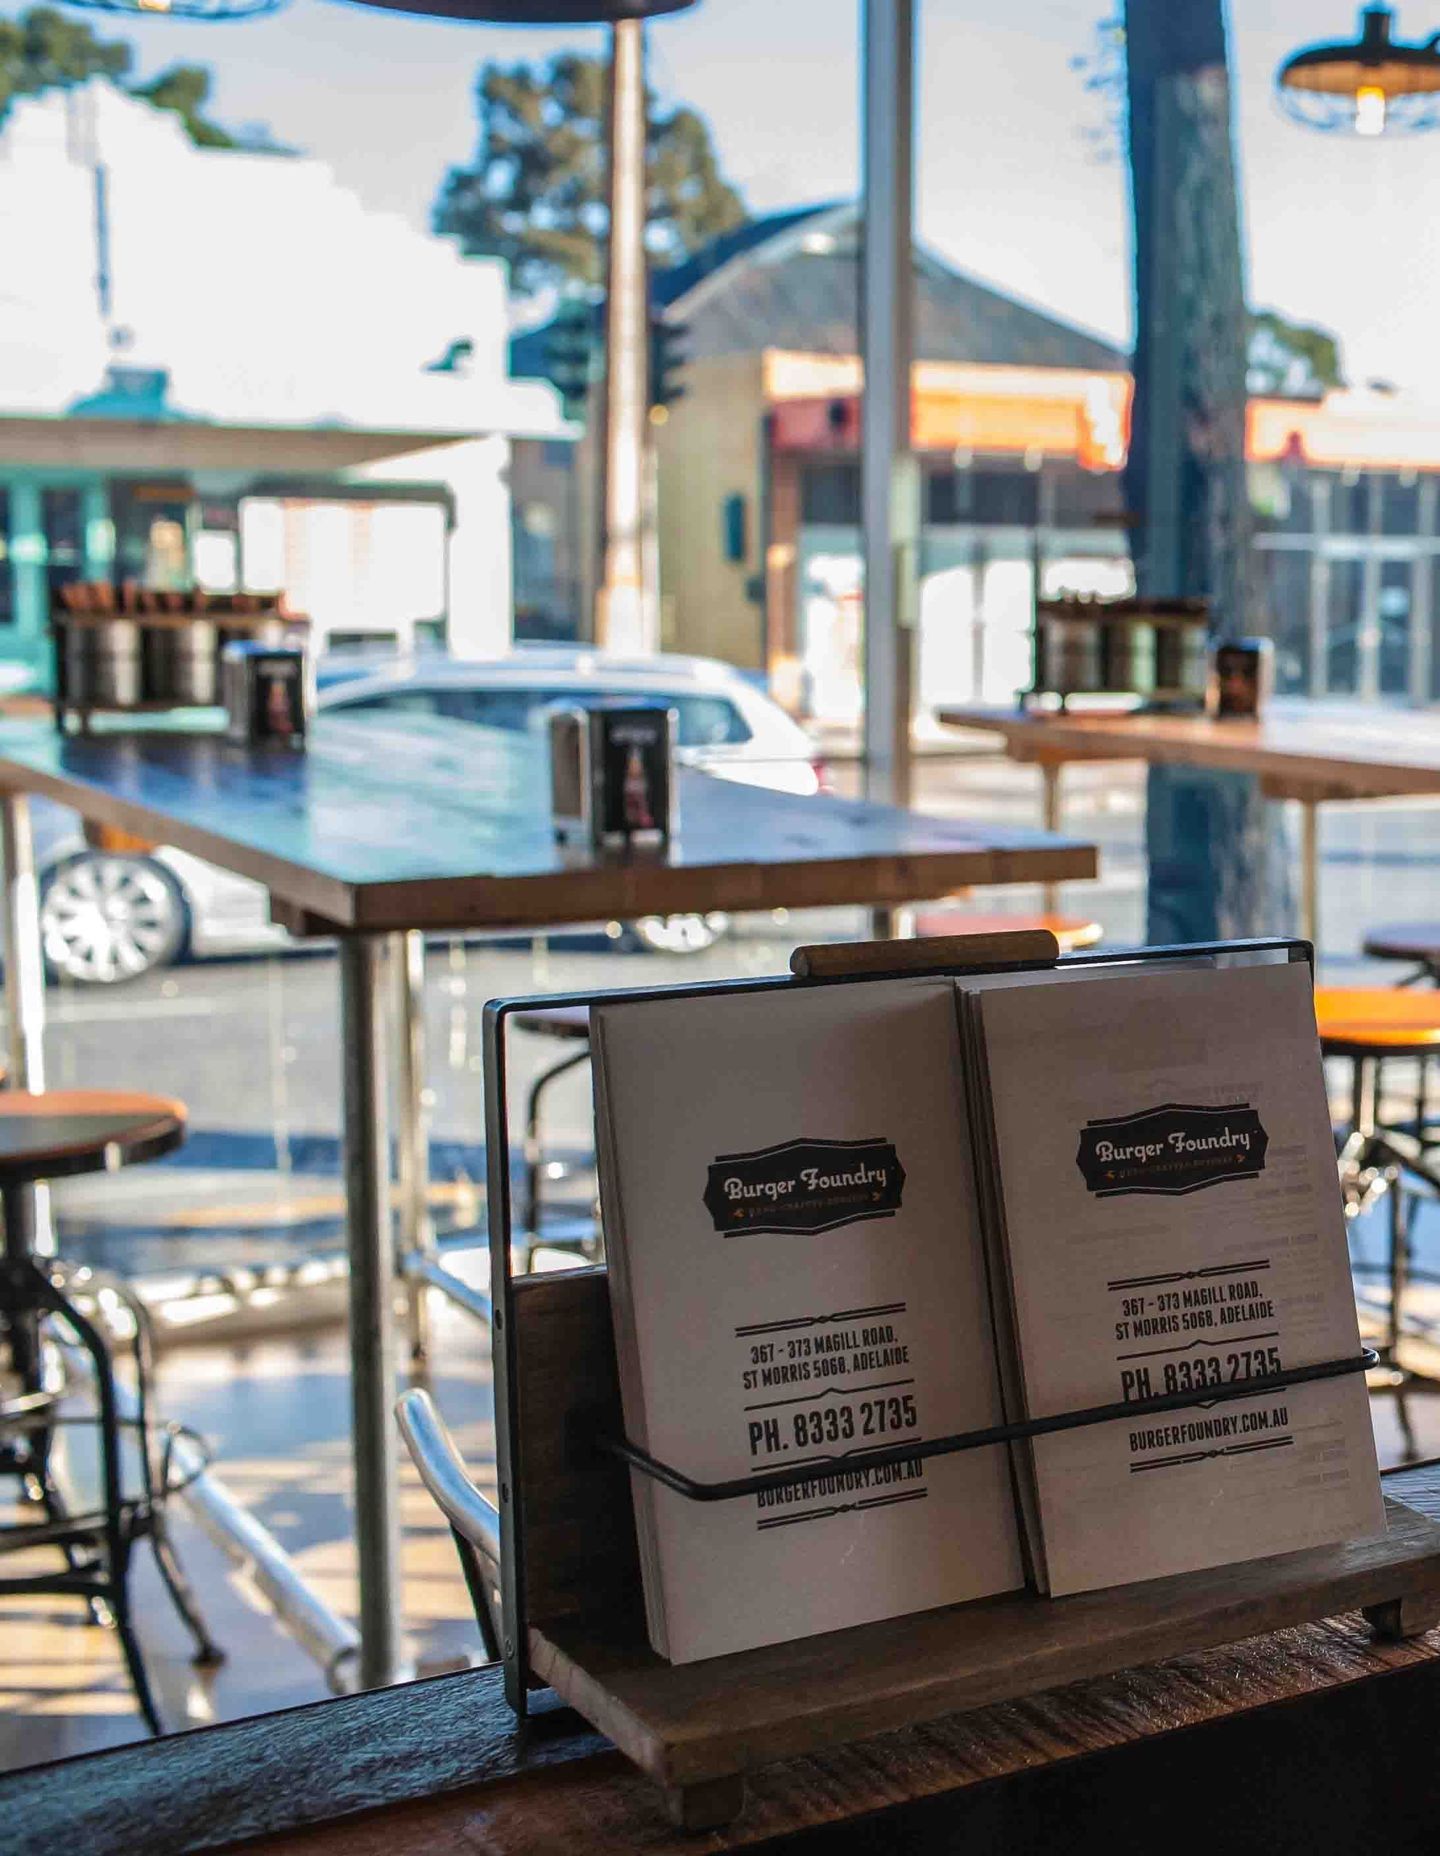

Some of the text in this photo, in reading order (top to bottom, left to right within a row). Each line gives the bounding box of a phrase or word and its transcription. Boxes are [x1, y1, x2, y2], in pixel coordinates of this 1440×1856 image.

[1095, 1126, 1250, 1162] Burger Foundry
[723, 1162, 887, 1201] Burger Foundry
[1115, 1321, 1130, 1340] ST
[1133, 1315, 1180, 1338] MORRIS
[1219, 1300, 1275, 1325] ADELAIDE
[1122, 1296, 1145, 1317] 367
[1158, 1292, 1180, 1312] 373
[1183, 1286, 1227, 1307] MAGILL
[742, 1370, 758, 1390] ST
[763, 1362, 811, 1386] MORRIS
[853, 1346, 910, 1373] ADELAIDE
[750, 1343, 774, 1365] 367
[787, 1339, 812, 1360] 373
[815, 1332, 861, 1354] MAGILL
[1163, 1356, 1222, 1395] 8333
[1226, 1347, 1282, 1381] 2735
[748, 1395, 917, 1455] PH. 8333 2735
[1129, 1407, 1289, 1452] BURGERFOUNDRY.COM.AU
